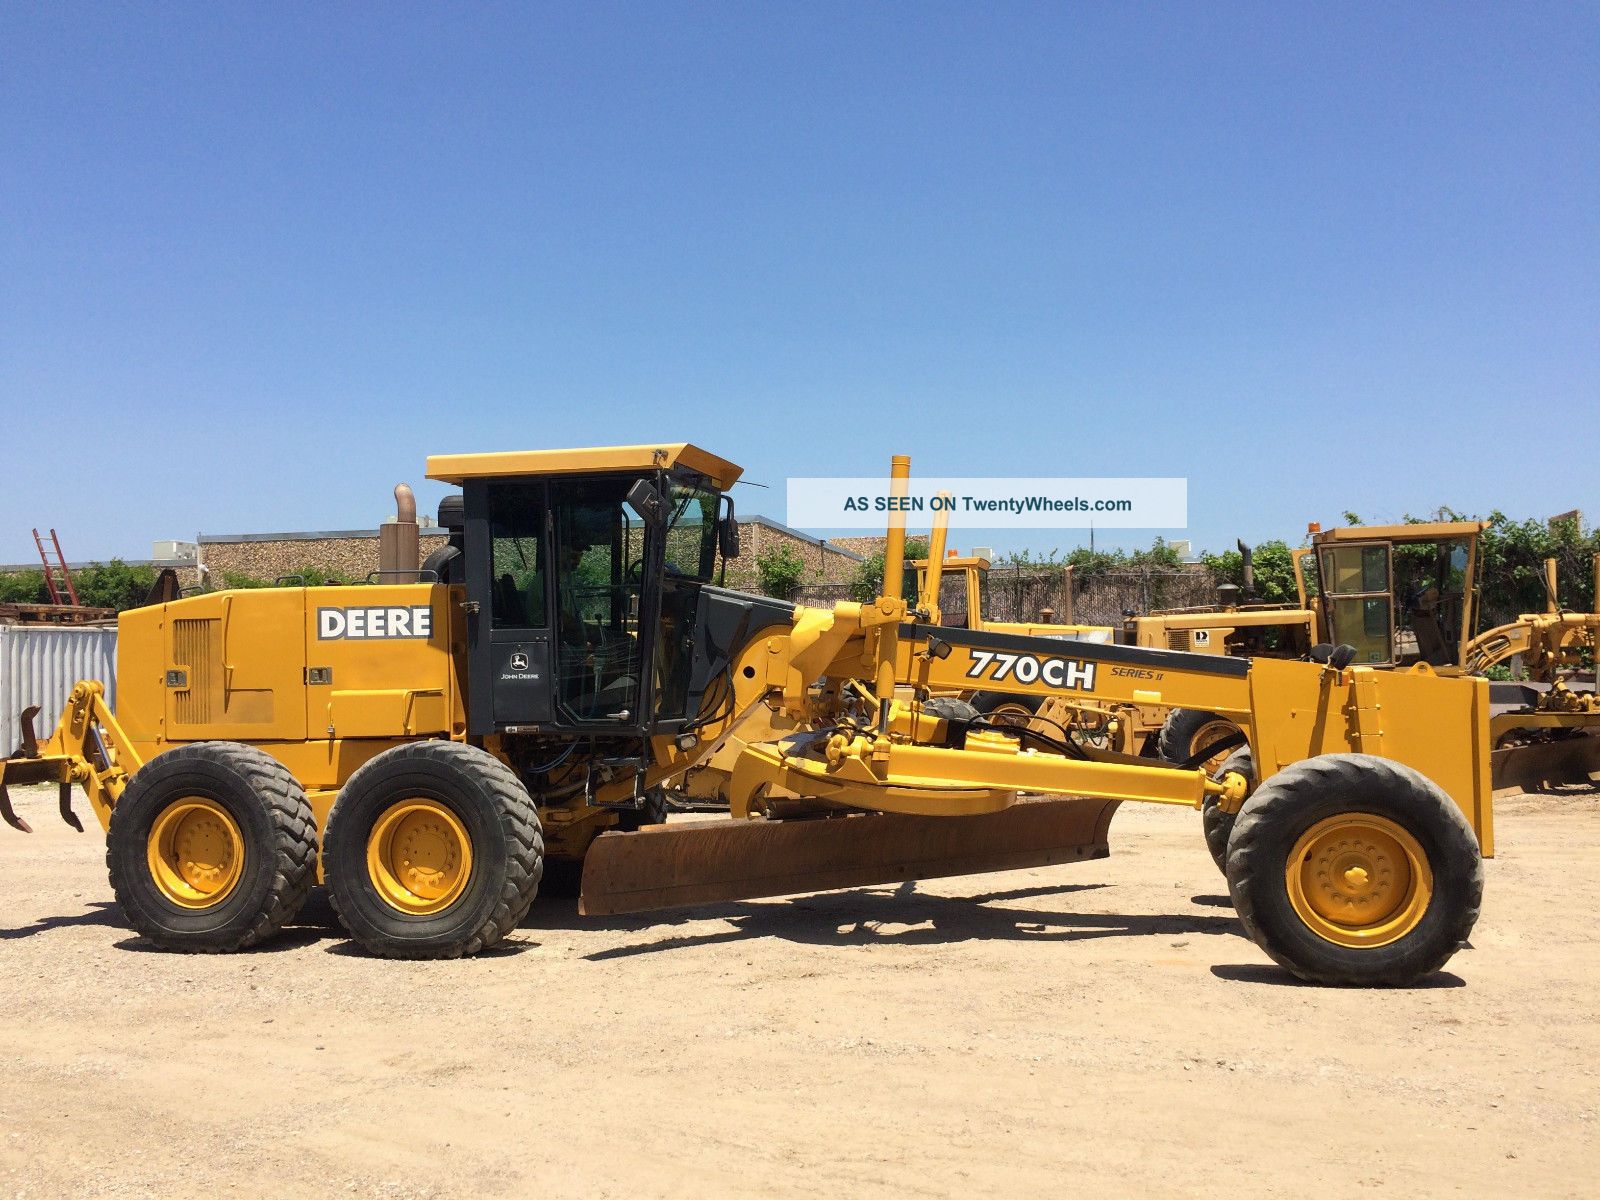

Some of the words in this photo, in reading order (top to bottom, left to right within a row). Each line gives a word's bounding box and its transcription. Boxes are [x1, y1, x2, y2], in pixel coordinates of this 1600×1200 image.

[320, 608, 431, 638] DEERE
[967, 649, 1095, 691] 770CH
[1110, 667, 1154, 680] SERIES
